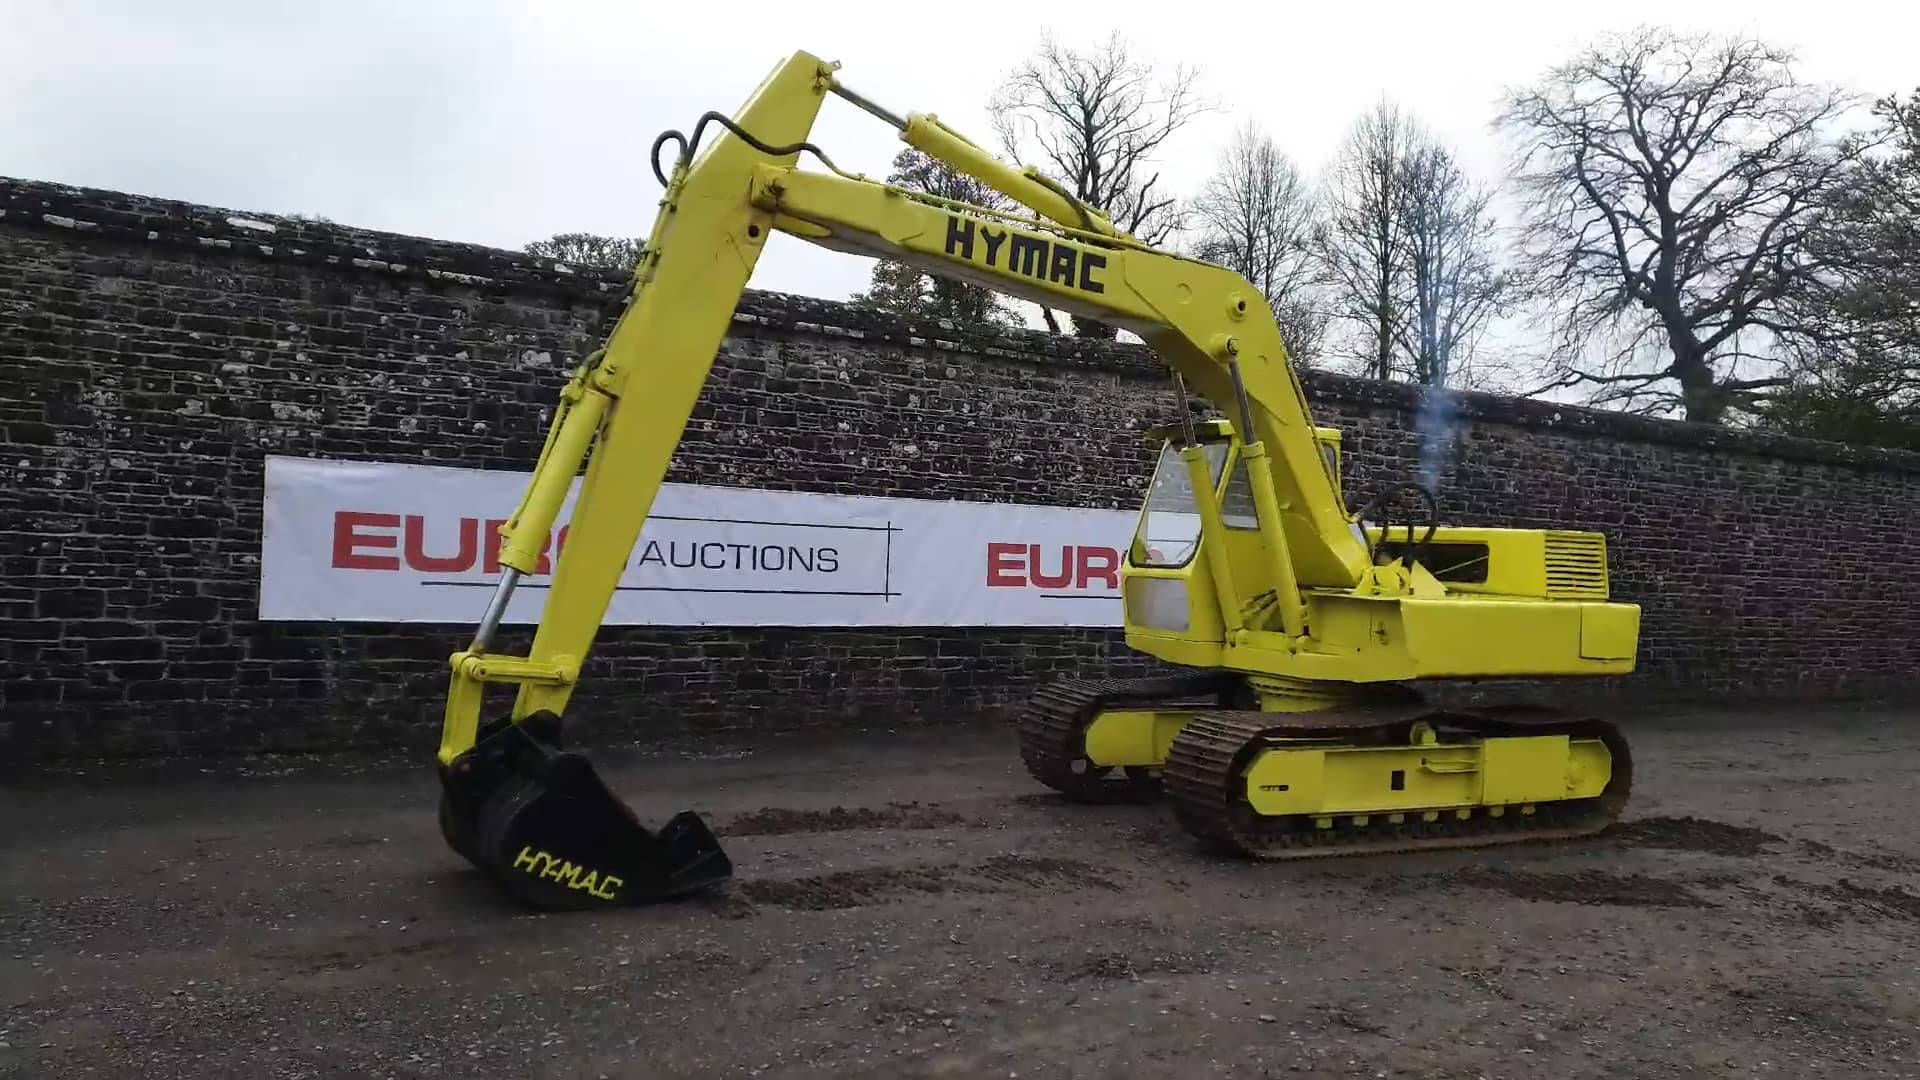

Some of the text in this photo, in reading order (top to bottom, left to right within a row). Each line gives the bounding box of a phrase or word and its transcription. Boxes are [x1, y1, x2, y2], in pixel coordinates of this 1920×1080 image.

[945, 214, 1107, 294] HYMAC
[638, 540, 839, 573] AUCTIONS
[987, 542, 1164, 590] EUR
